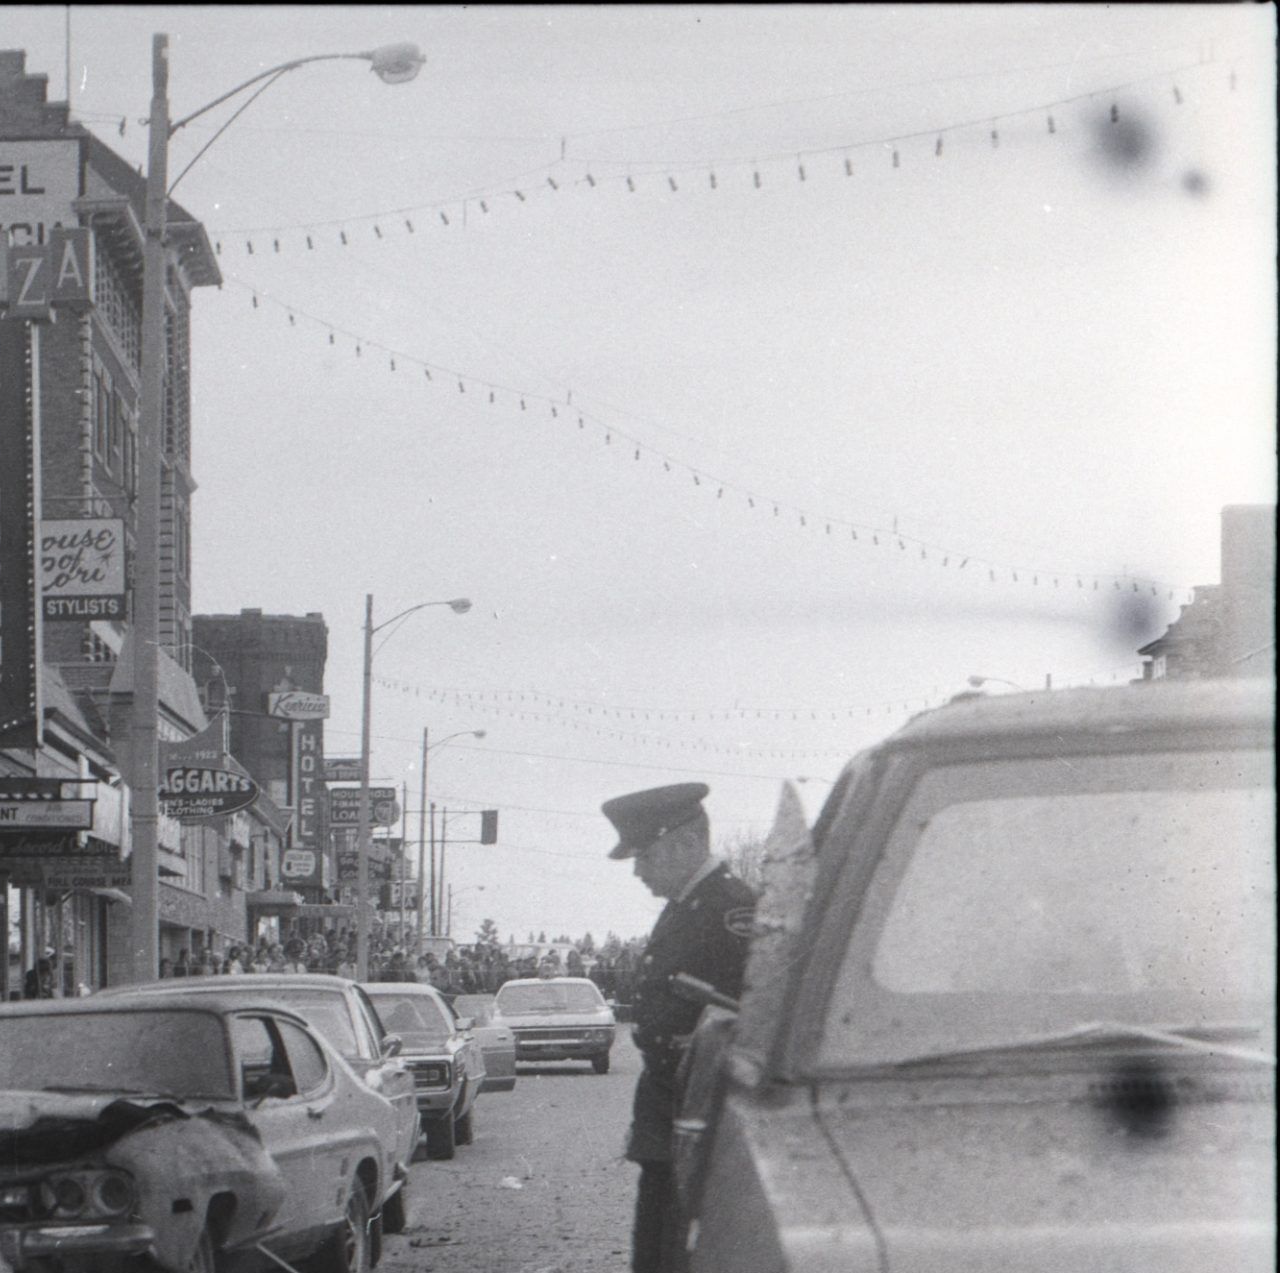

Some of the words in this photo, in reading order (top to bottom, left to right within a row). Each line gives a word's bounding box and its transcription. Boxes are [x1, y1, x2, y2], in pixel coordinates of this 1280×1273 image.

[41, 528, 116, 552] ouse
[46, 598, 119, 615] STYLISTS
[158, 769, 251, 793] AGGARTS
[301, 734, 315, 837] HOTEL
